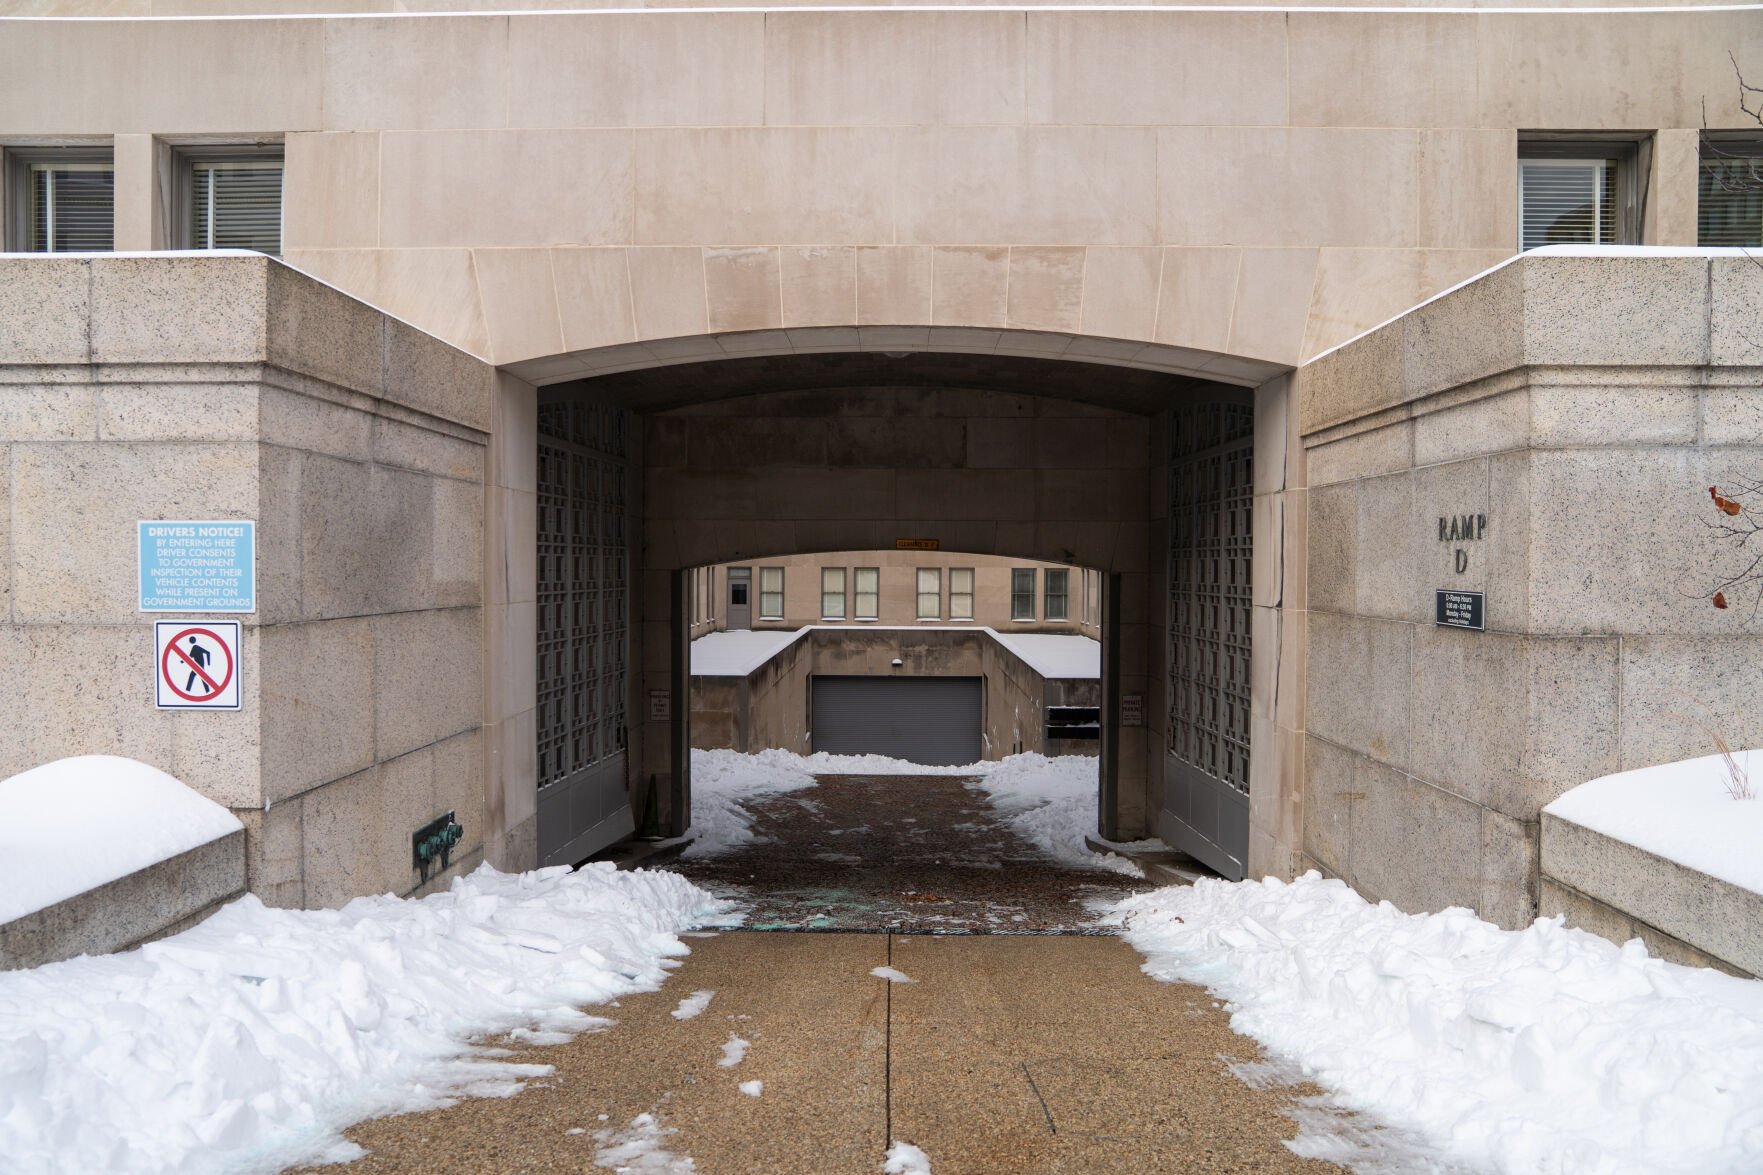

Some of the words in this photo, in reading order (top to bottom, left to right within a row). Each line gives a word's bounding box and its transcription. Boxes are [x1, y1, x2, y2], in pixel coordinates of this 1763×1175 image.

[1439, 513, 1486, 541] RAMP
[148, 528, 195, 536] DRIVERS
[199, 528, 244, 536] NOTICE!
[156, 539, 166, 547] BY
[170, 539, 212, 547] ENTERING
[214, 539, 236, 547] HERE
[157, 549, 186, 557] DRIVER
[189, 549, 236, 557] CONSENTS
[1456, 549, 1467, 574] D
[150, 568, 202, 576] INSPECTION
[204, 568, 216, 576] OF
[220, 568, 242, 576] THEIR
[155, 578, 189, 586] VEHICLE
[192, 578, 238, 586] CONTENTS
[156, 588, 182, 596] WHILE
[185, 588, 220, 596] PRESENT
[222, 588, 238, 596] ON
[144, 598, 204, 606] GOVERNMENT
[206, 598, 250, 606] GROUNDS
[1446, 594, 1460, 603] D-Ramp
[1446, 610, 1458, 618] Monday
[1461, 611, 1472, 620] Friday
